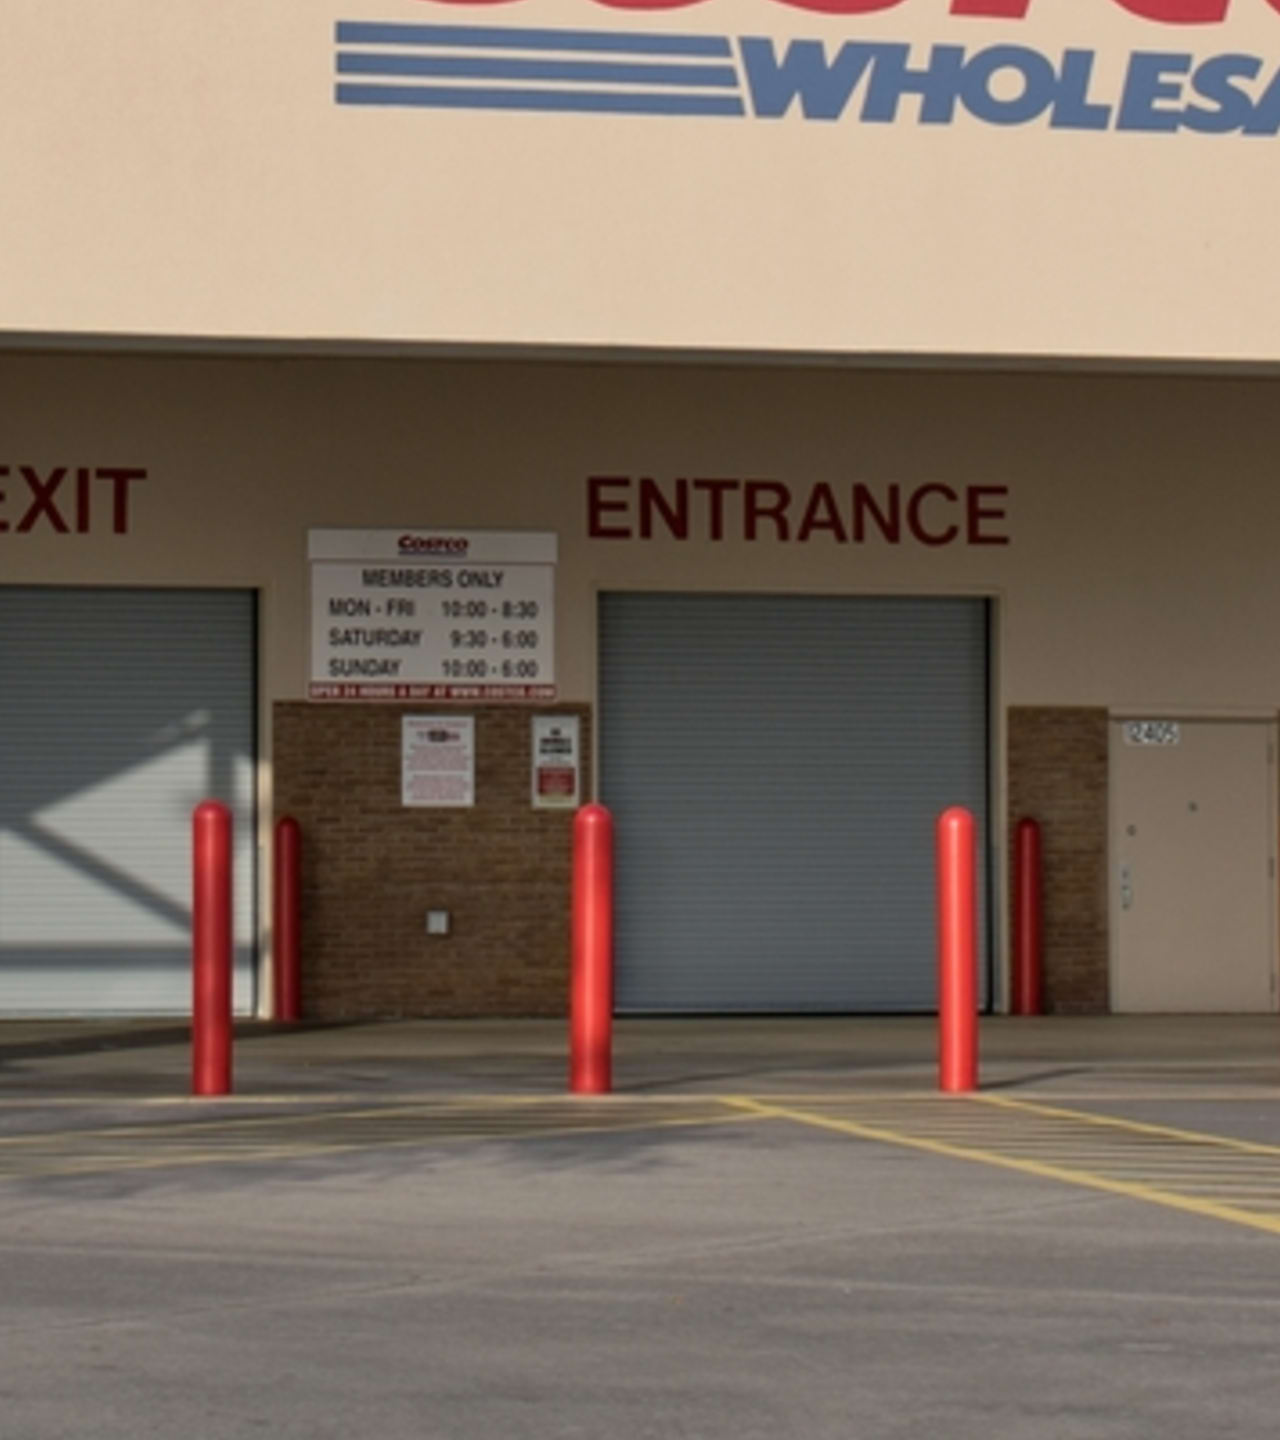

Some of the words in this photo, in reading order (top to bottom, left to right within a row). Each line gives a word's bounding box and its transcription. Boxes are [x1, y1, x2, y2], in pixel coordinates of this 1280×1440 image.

[586, 475, 1011, 547] ENTRANCE
[397, 534, 469, 550] COSTCO
[361, 568, 453, 588] MEMBERS
[456, 569, 505, 589] ONLY
[328, 597, 371, 616] MON
[386, 598, 416, 617] FRI
[441, 599, 489, 619] 10:00
[328, 627, 422, 647] SATURDAY
[449, 629, 488, 649] 9:30
[328, 657, 401, 677] SUNDAY
[441, 658, 489, 678] 10:00
